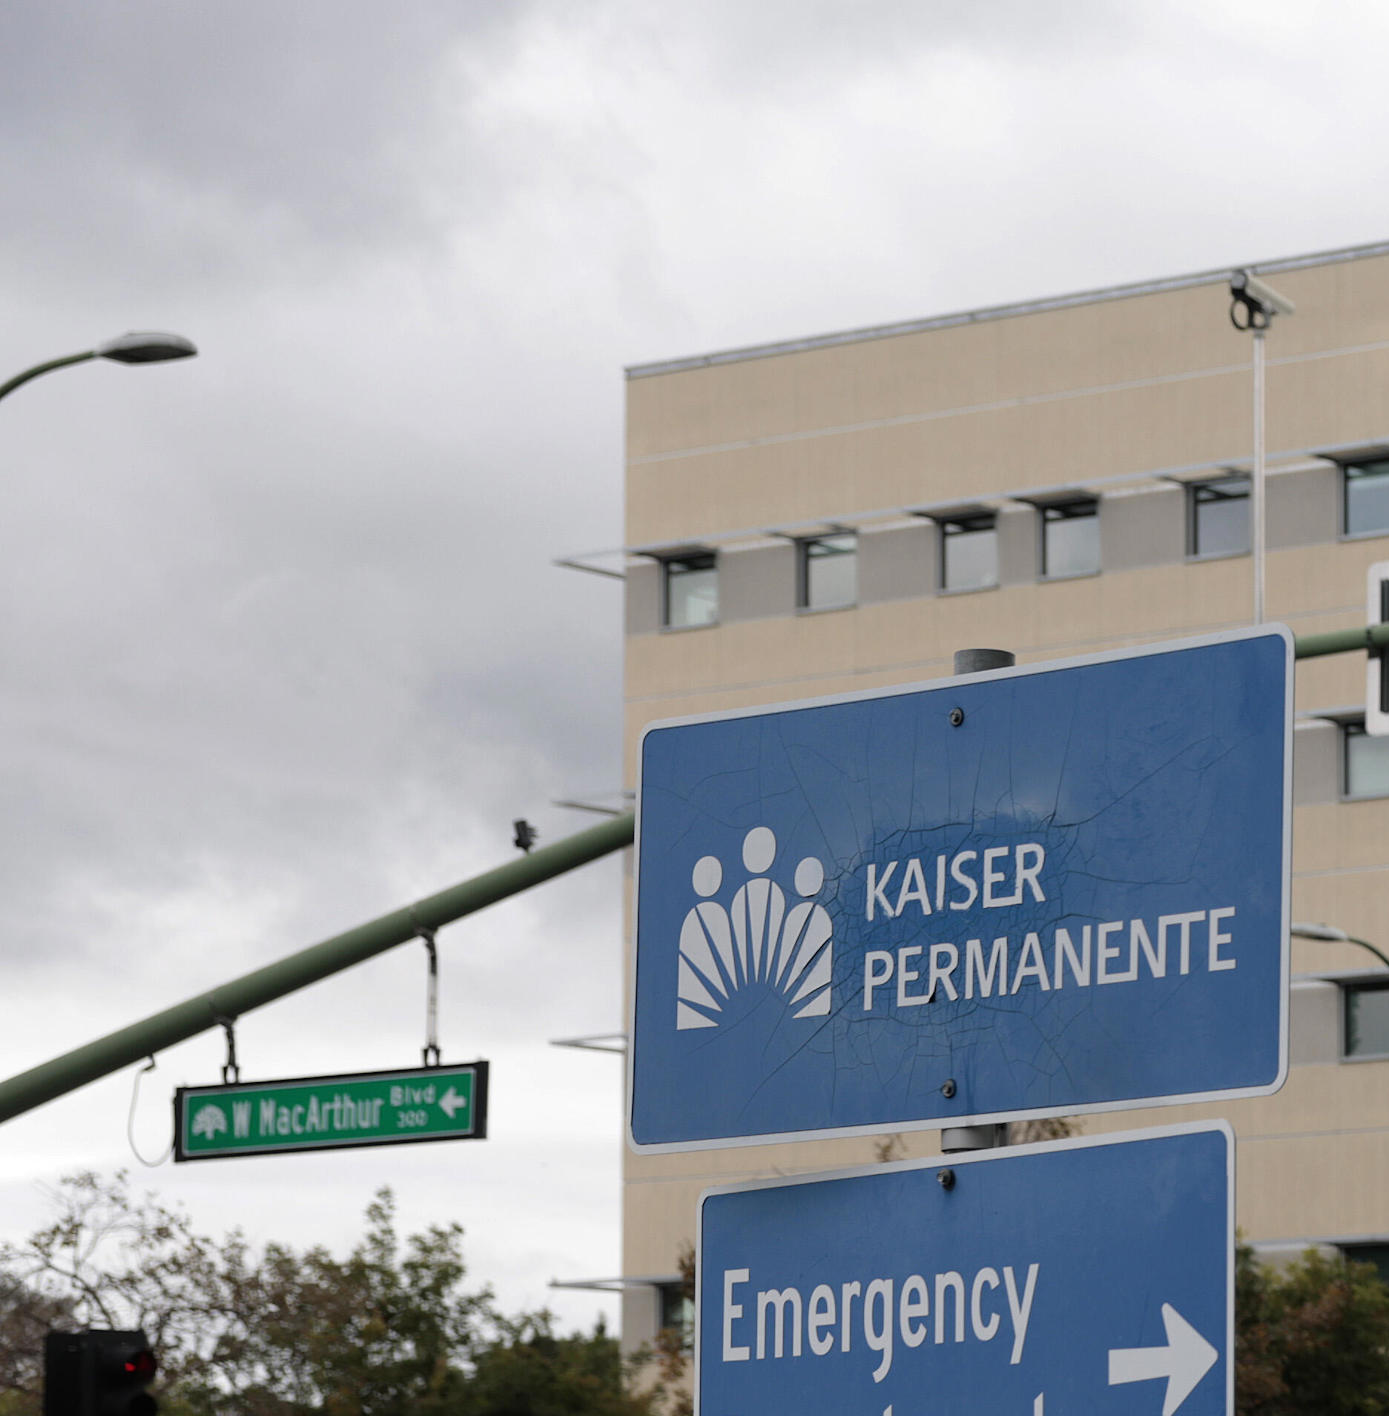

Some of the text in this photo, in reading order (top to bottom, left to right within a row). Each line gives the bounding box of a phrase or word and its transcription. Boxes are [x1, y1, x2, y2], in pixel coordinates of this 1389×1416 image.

[865, 843, 1045, 921] KAISER
[863, 907, 1237, 1010] PERMANENTE
[232, 1093, 384, 1138] W MacArthur
[390, 1084, 436, 1106] Blvd
[722, 1263, 1039, 1381] Emergency
